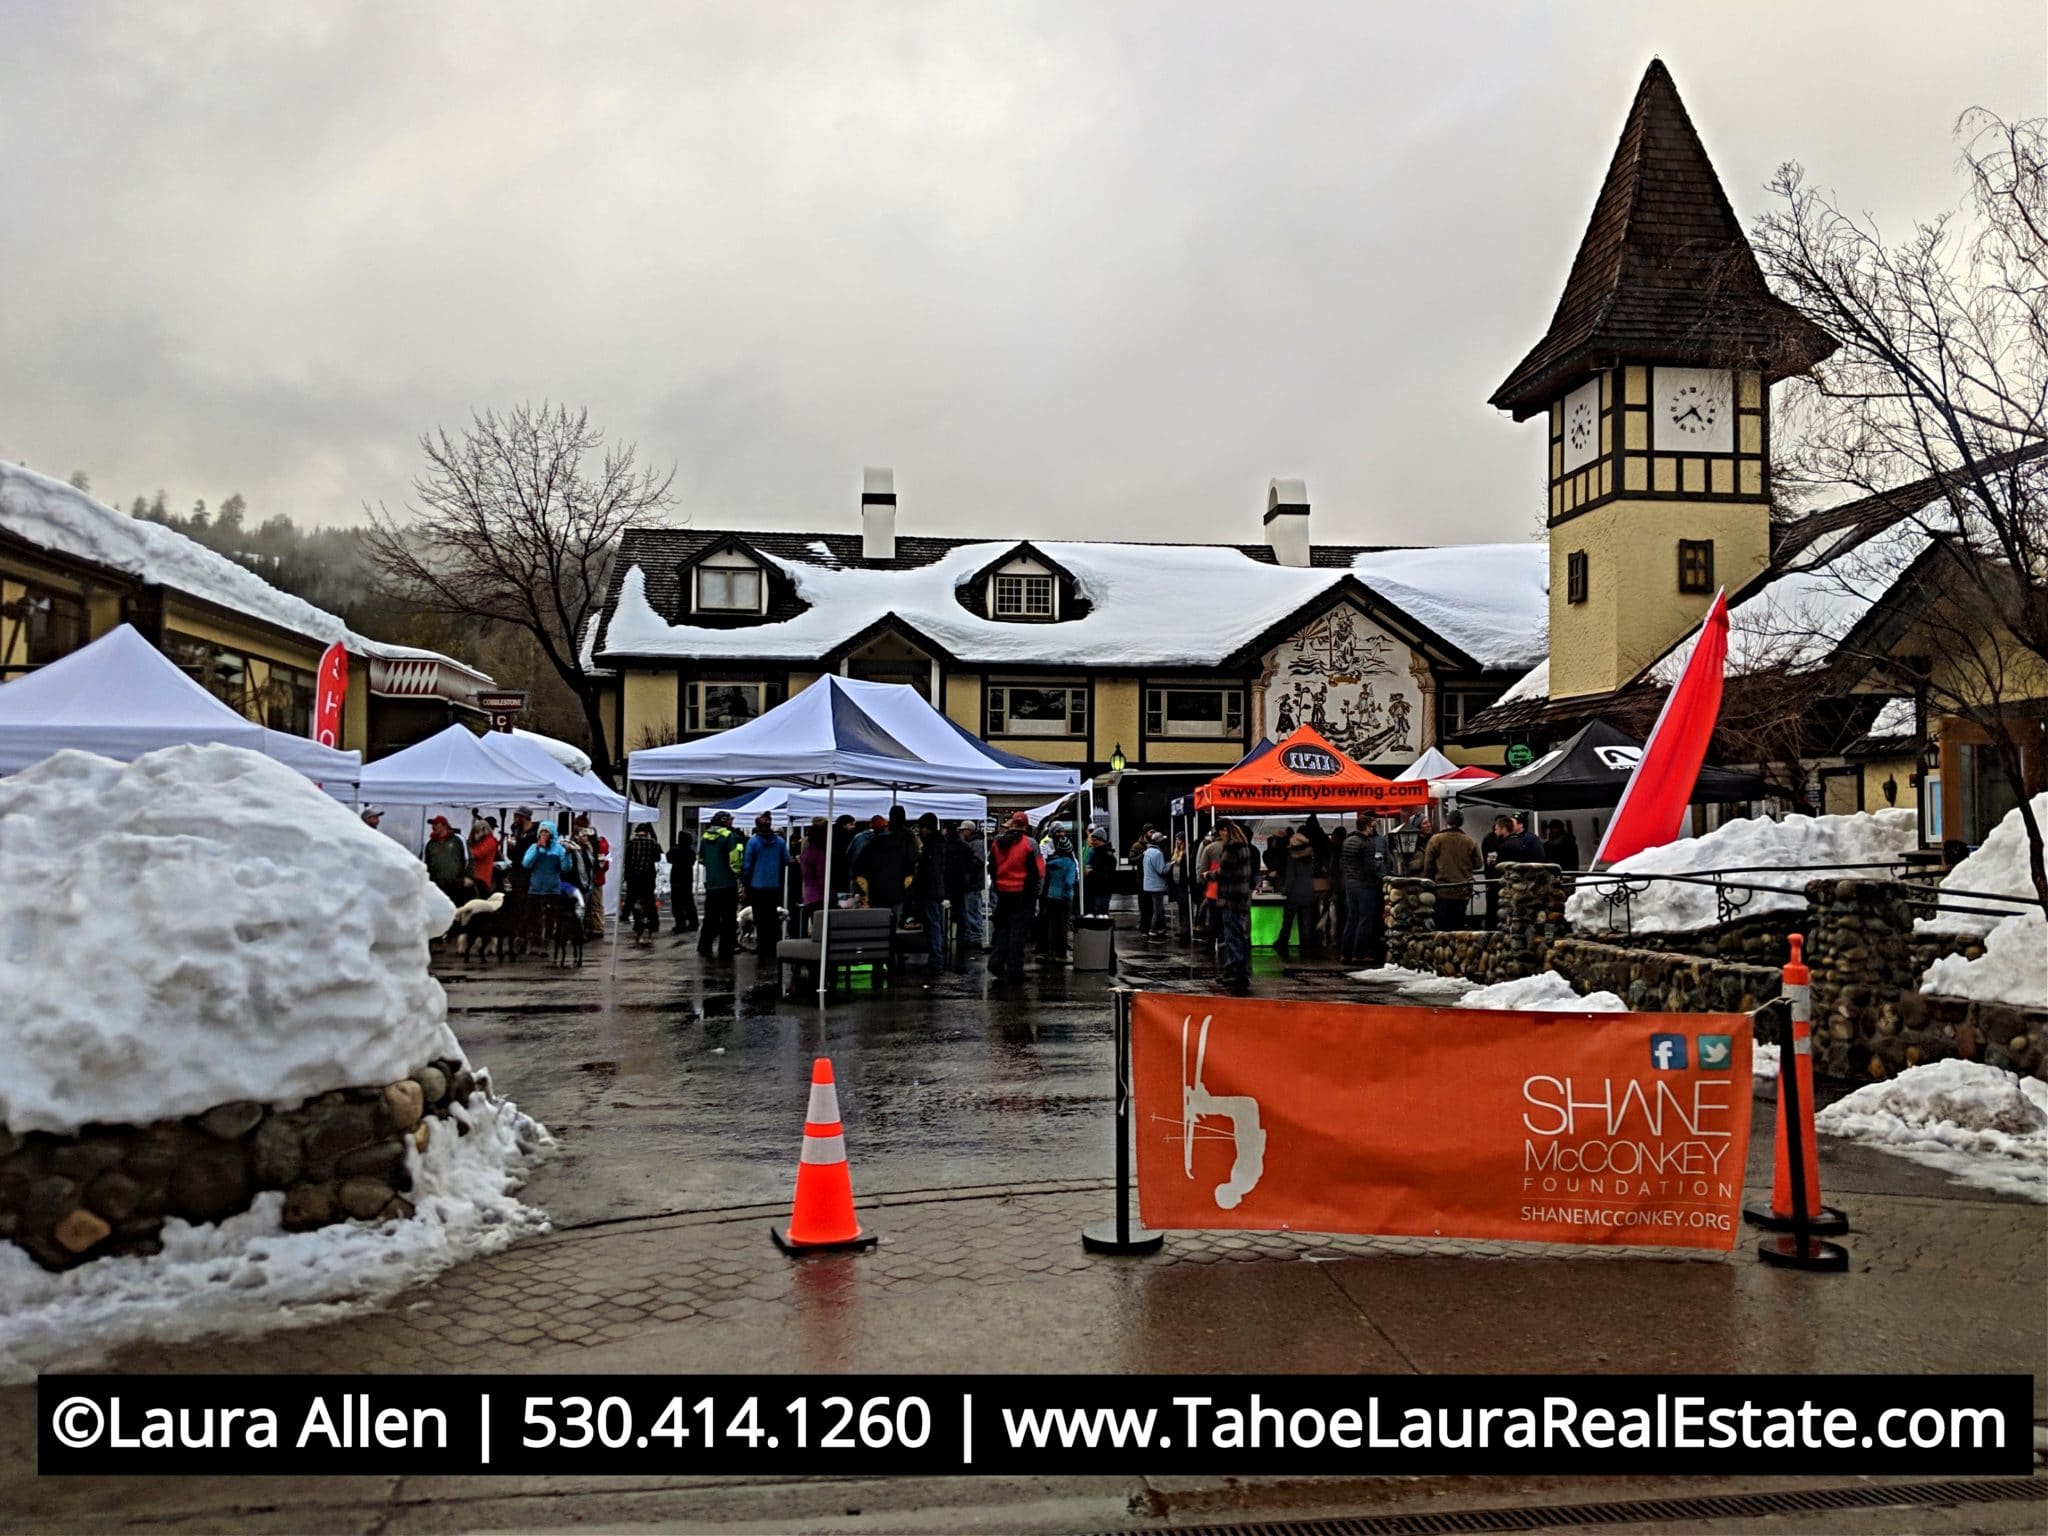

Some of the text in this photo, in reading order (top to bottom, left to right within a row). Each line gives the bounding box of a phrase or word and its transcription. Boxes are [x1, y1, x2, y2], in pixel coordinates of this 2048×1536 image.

[1219, 783, 1423, 800] www.fiftyfiftybrewing.com
[1654, 1040, 1674, 1070] f
[1522, 1074, 1732, 1136] SHANE
[1525, 1138, 1731, 1175] McCONKEY
[1523, 1177, 1733, 1199] FOUNDATION
[1520, 1206, 1731, 1231] SHANEMCCONKEY.ORG
